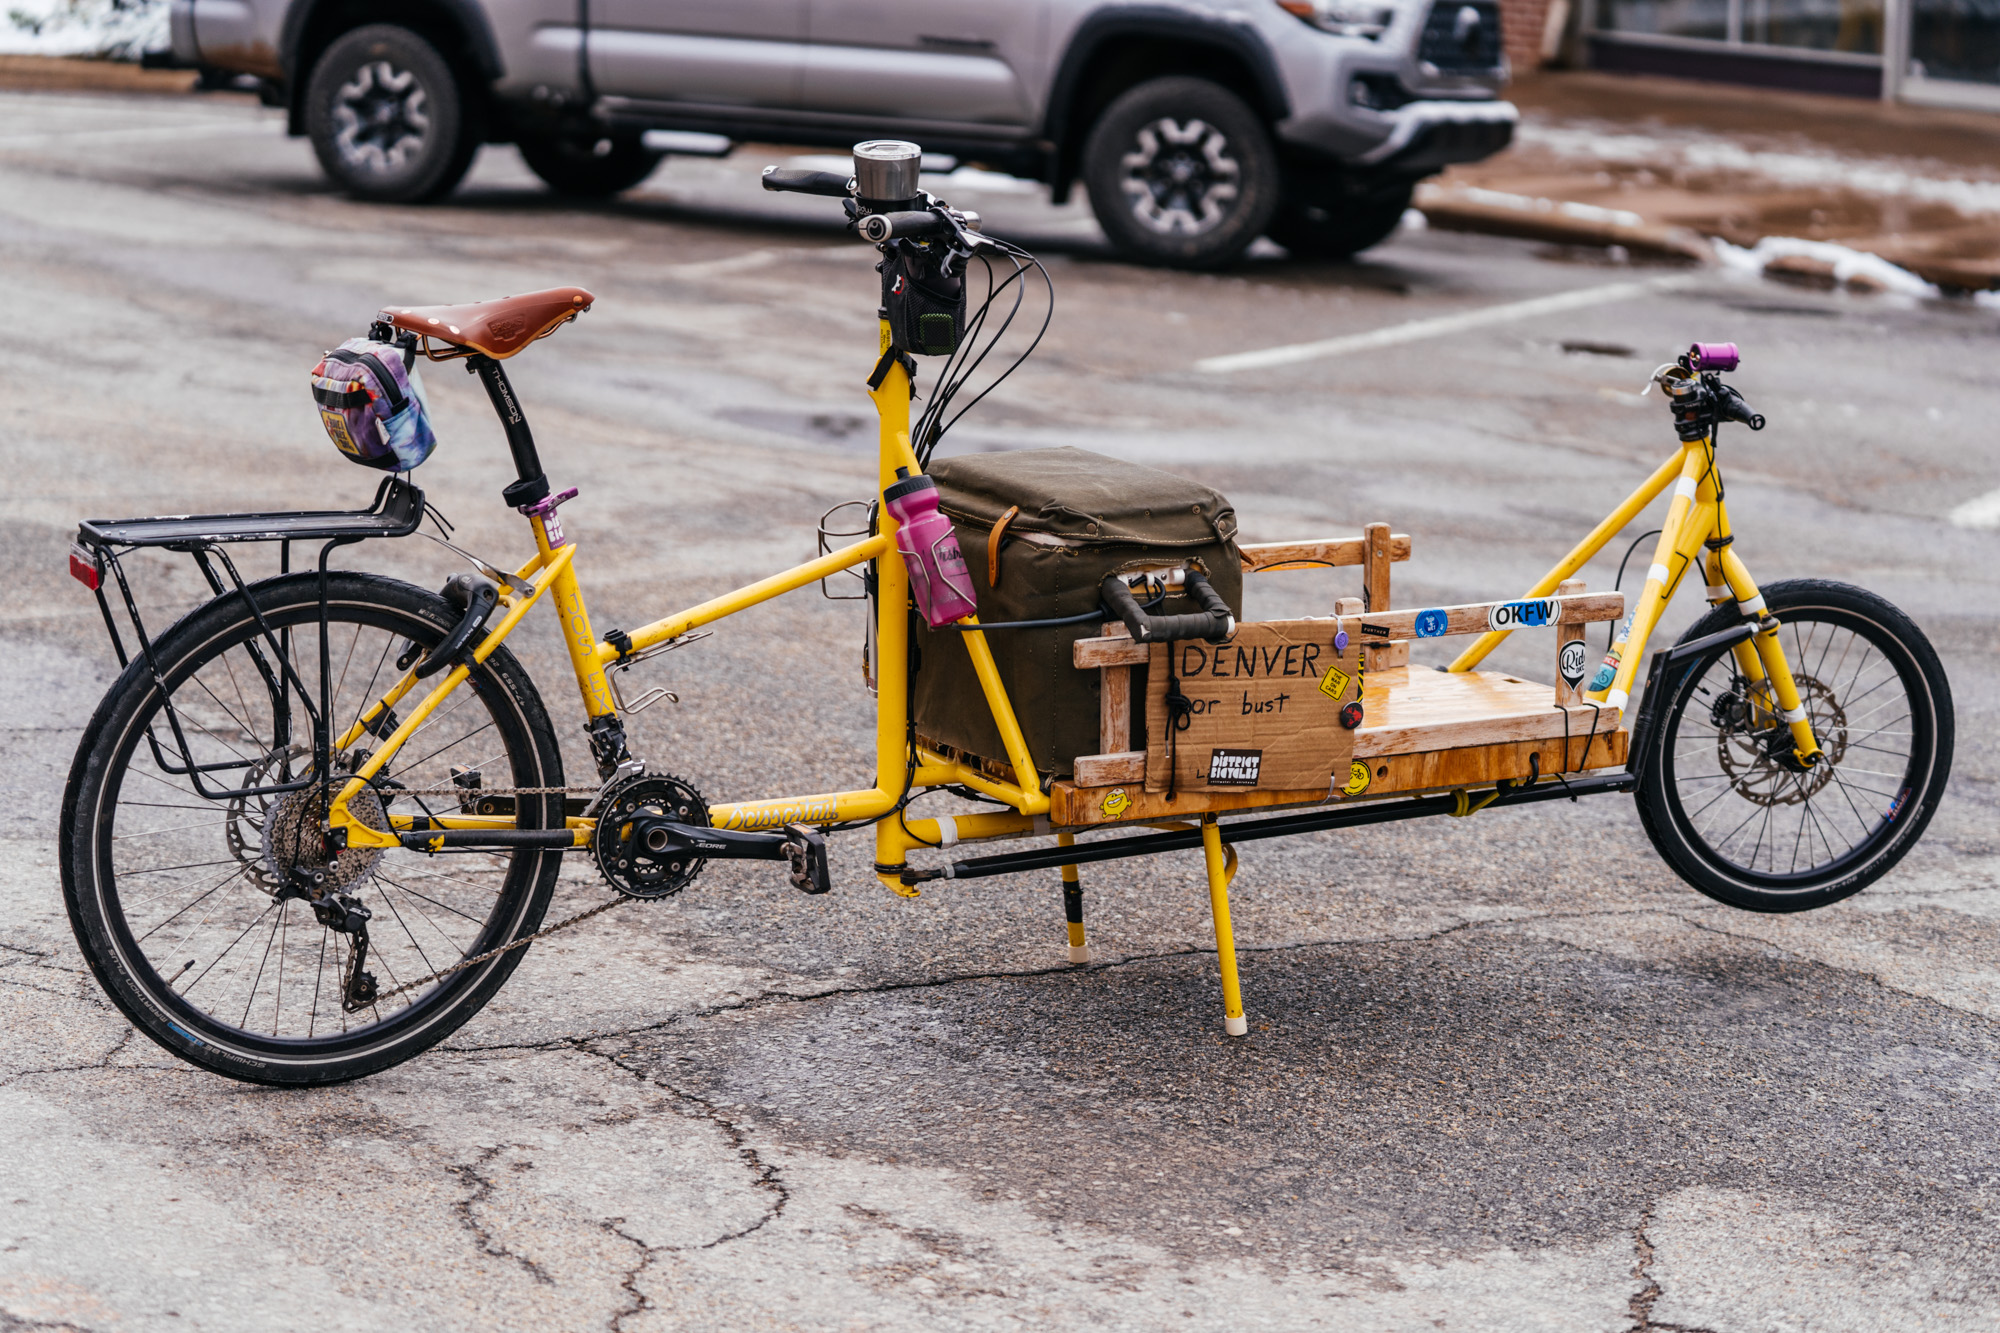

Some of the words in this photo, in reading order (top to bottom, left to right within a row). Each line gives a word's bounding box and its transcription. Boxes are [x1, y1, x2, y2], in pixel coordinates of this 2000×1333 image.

[492, 366, 521, 423] THOMSON
[1496, 601, 1553, 625] OKFW
[1182, 643, 1320, 678] DENVER
[1191, 699, 1221, 715] or
[1241, 690, 1290, 715] bust
[1210, 766, 1259, 780] BICYCLES
[108, 949, 126, 975] PLUS
[125, 978, 168, 1023] MARATHON
[205, 1044, 267, 1068] SCHWALBE
